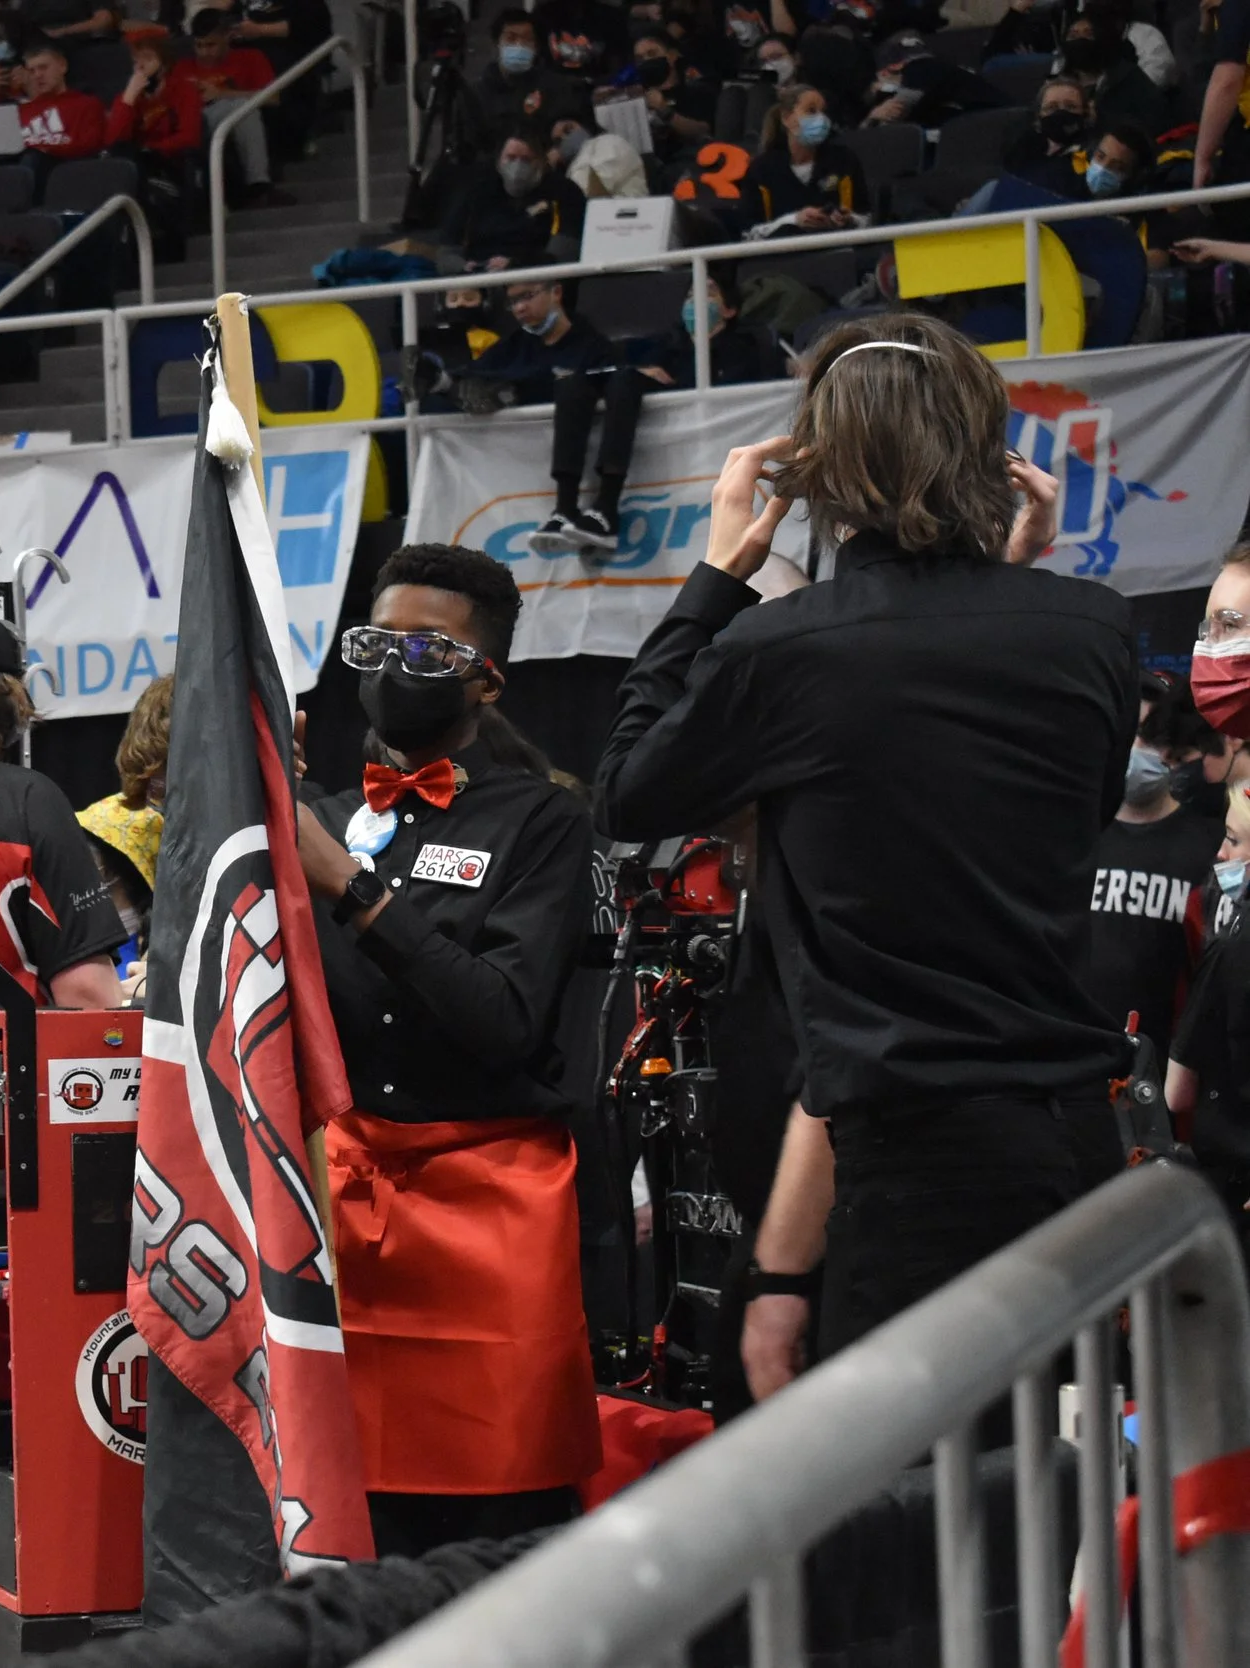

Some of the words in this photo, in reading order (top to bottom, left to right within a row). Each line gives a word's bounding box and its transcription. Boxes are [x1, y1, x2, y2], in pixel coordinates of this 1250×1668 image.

[414, 860, 456, 879] 2614
[419, 846, 464, 864] MARS
[1090, 868, 1191, 924] ERSON
[128, 1147, 247, 1342] RS
[83, 1310, 130, 1361] Mountain
[107, 1434, 146, 1463] MAR
